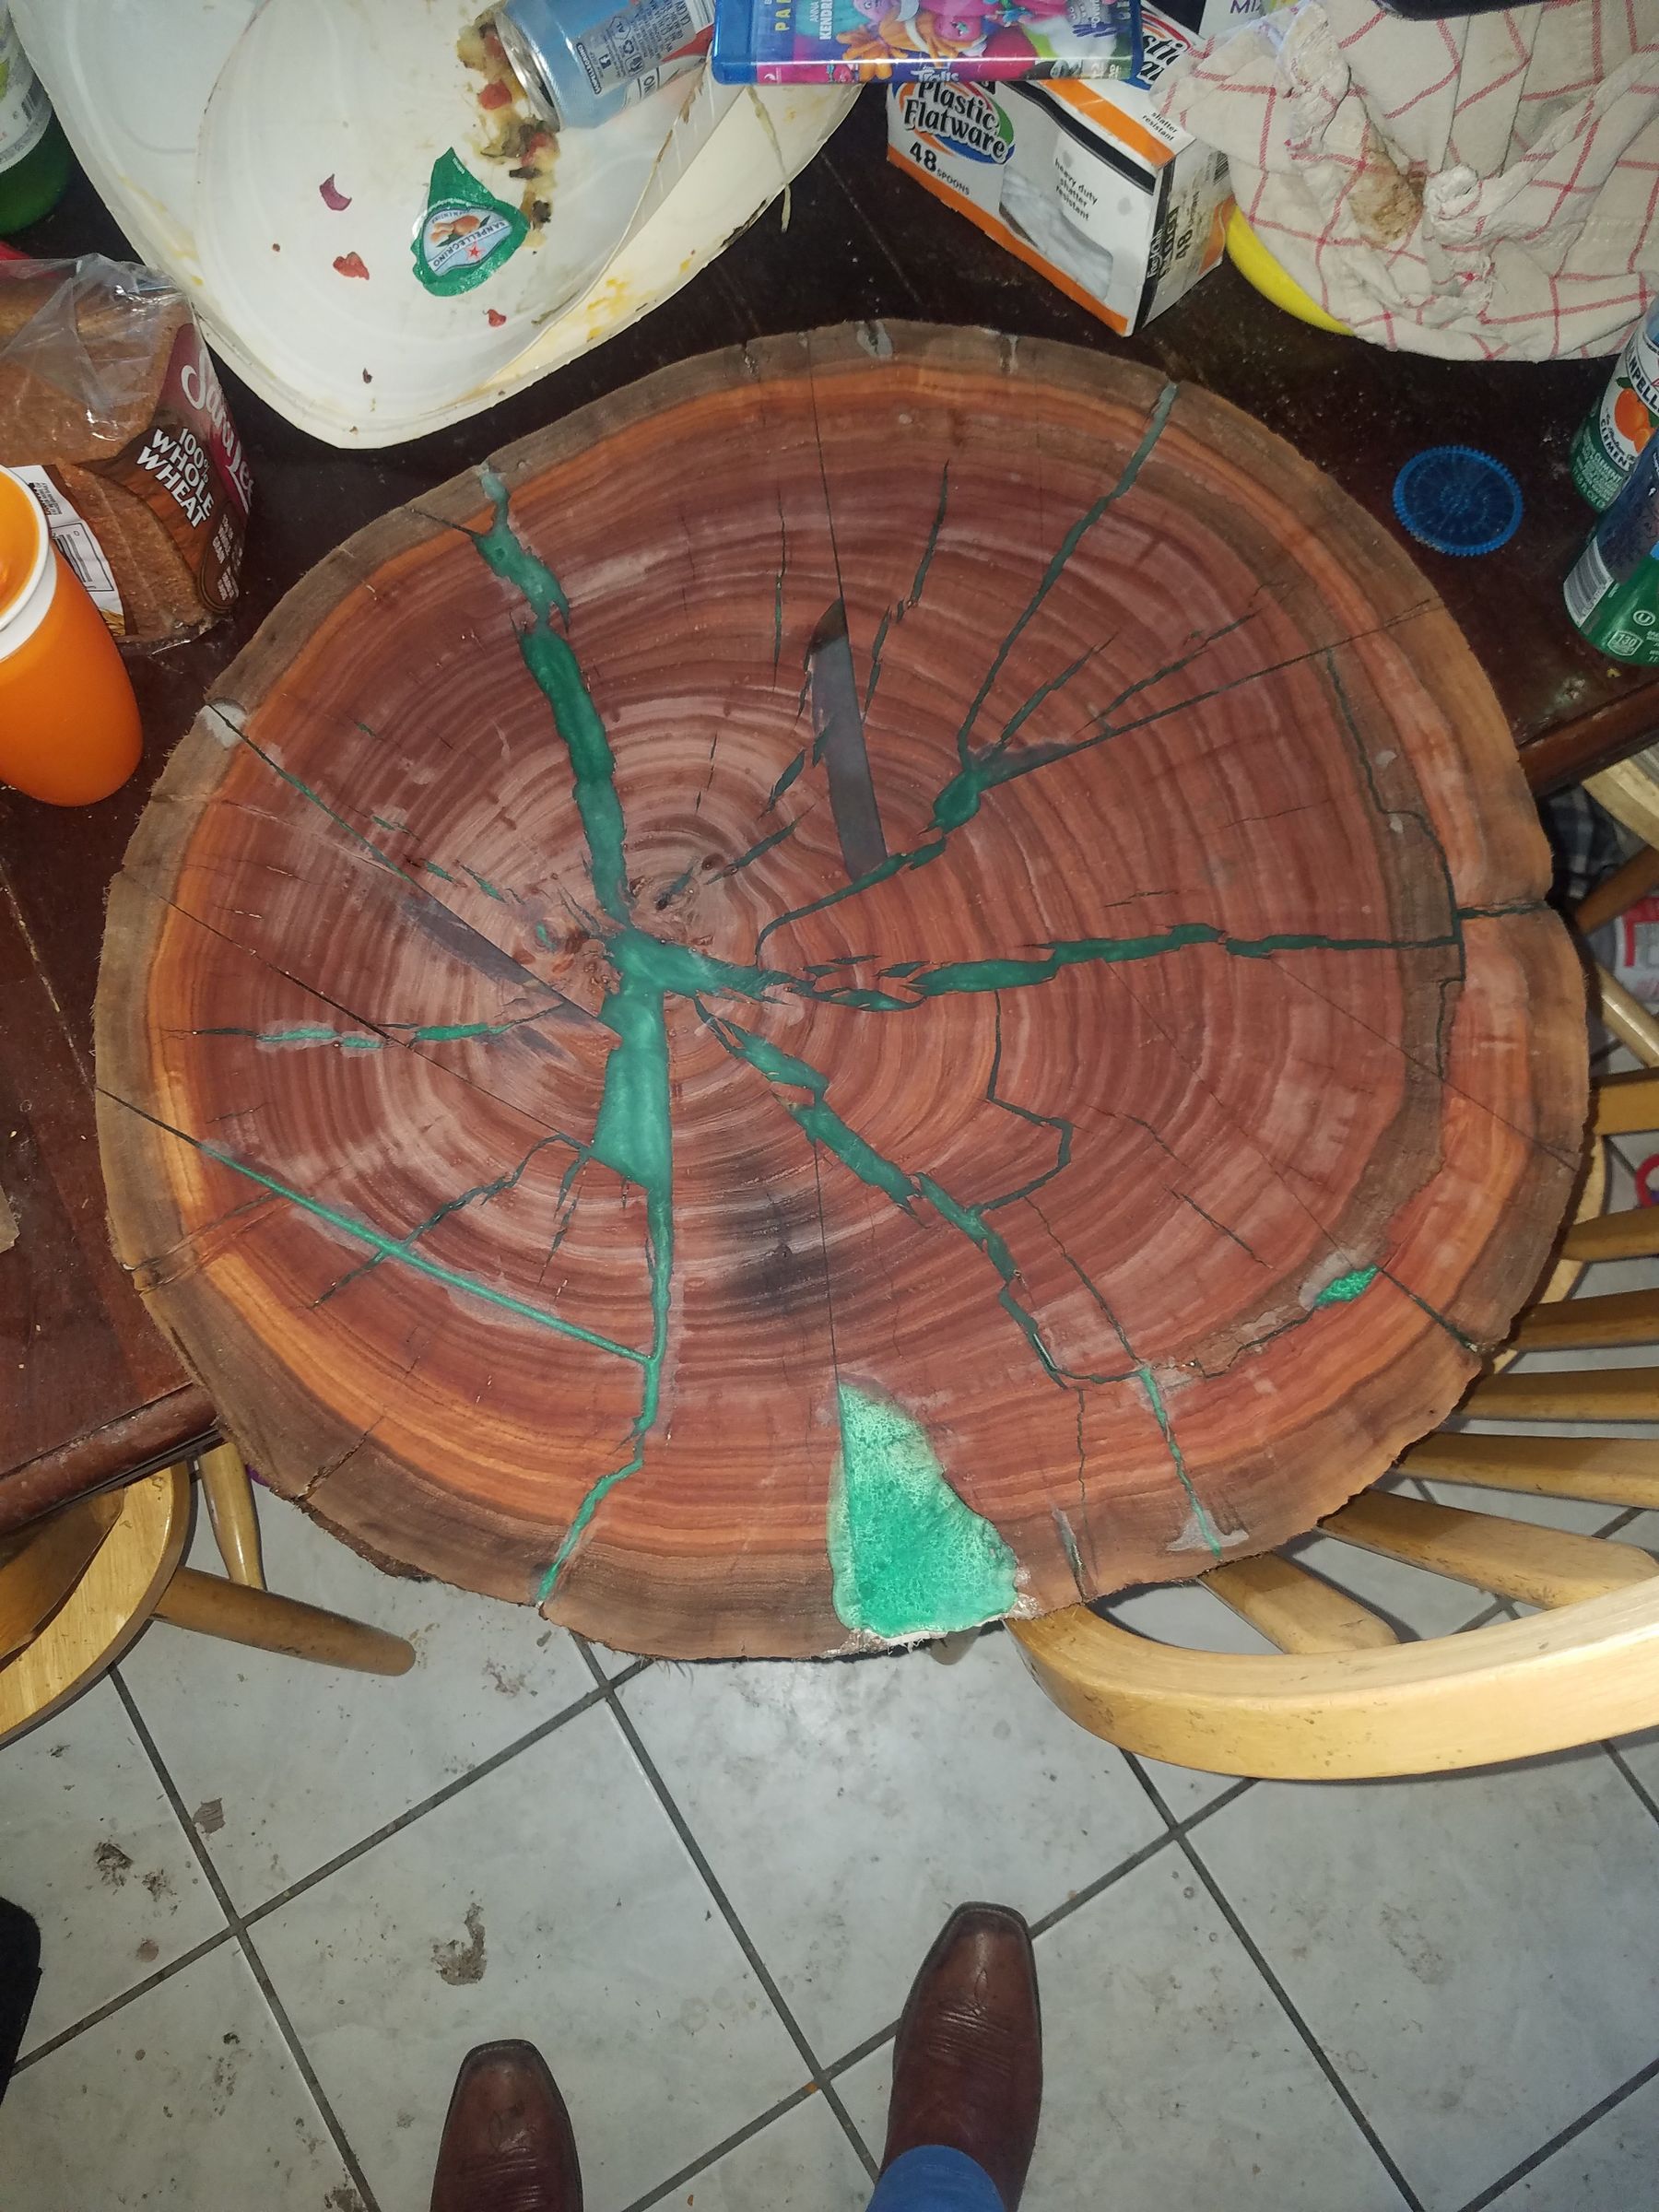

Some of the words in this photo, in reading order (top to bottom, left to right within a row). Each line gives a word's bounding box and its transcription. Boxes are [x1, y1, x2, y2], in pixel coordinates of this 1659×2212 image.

[809, 1, 820, 23] ANNA
[918, 79, 995, 131] Plastic
[1142, 114, 1175, 142] resistant
[1151, 112, 1178, 134] shatter
[904, 99, 1006, 159] Flatware
[909, 142, 937, 173] 48
[936, 169, 971, 196] SPOONS
[1054, 157, 1077, 187] heavy
[1078, 183, 1098, 206] duty
[1055, 185, 1089, 221] resistant
[1059, 178, 1088, 208] shatter
[432, 220, 506, 267] SANPELLEGRINO
[1175, 229, 1193, 260] 48
[152, 429, 215, 518] WHOLE
[179, 428, 210, 484] 100%
[136, 446, 206, 528] WHEAT
[1618, 632, 1638, 647] 130
